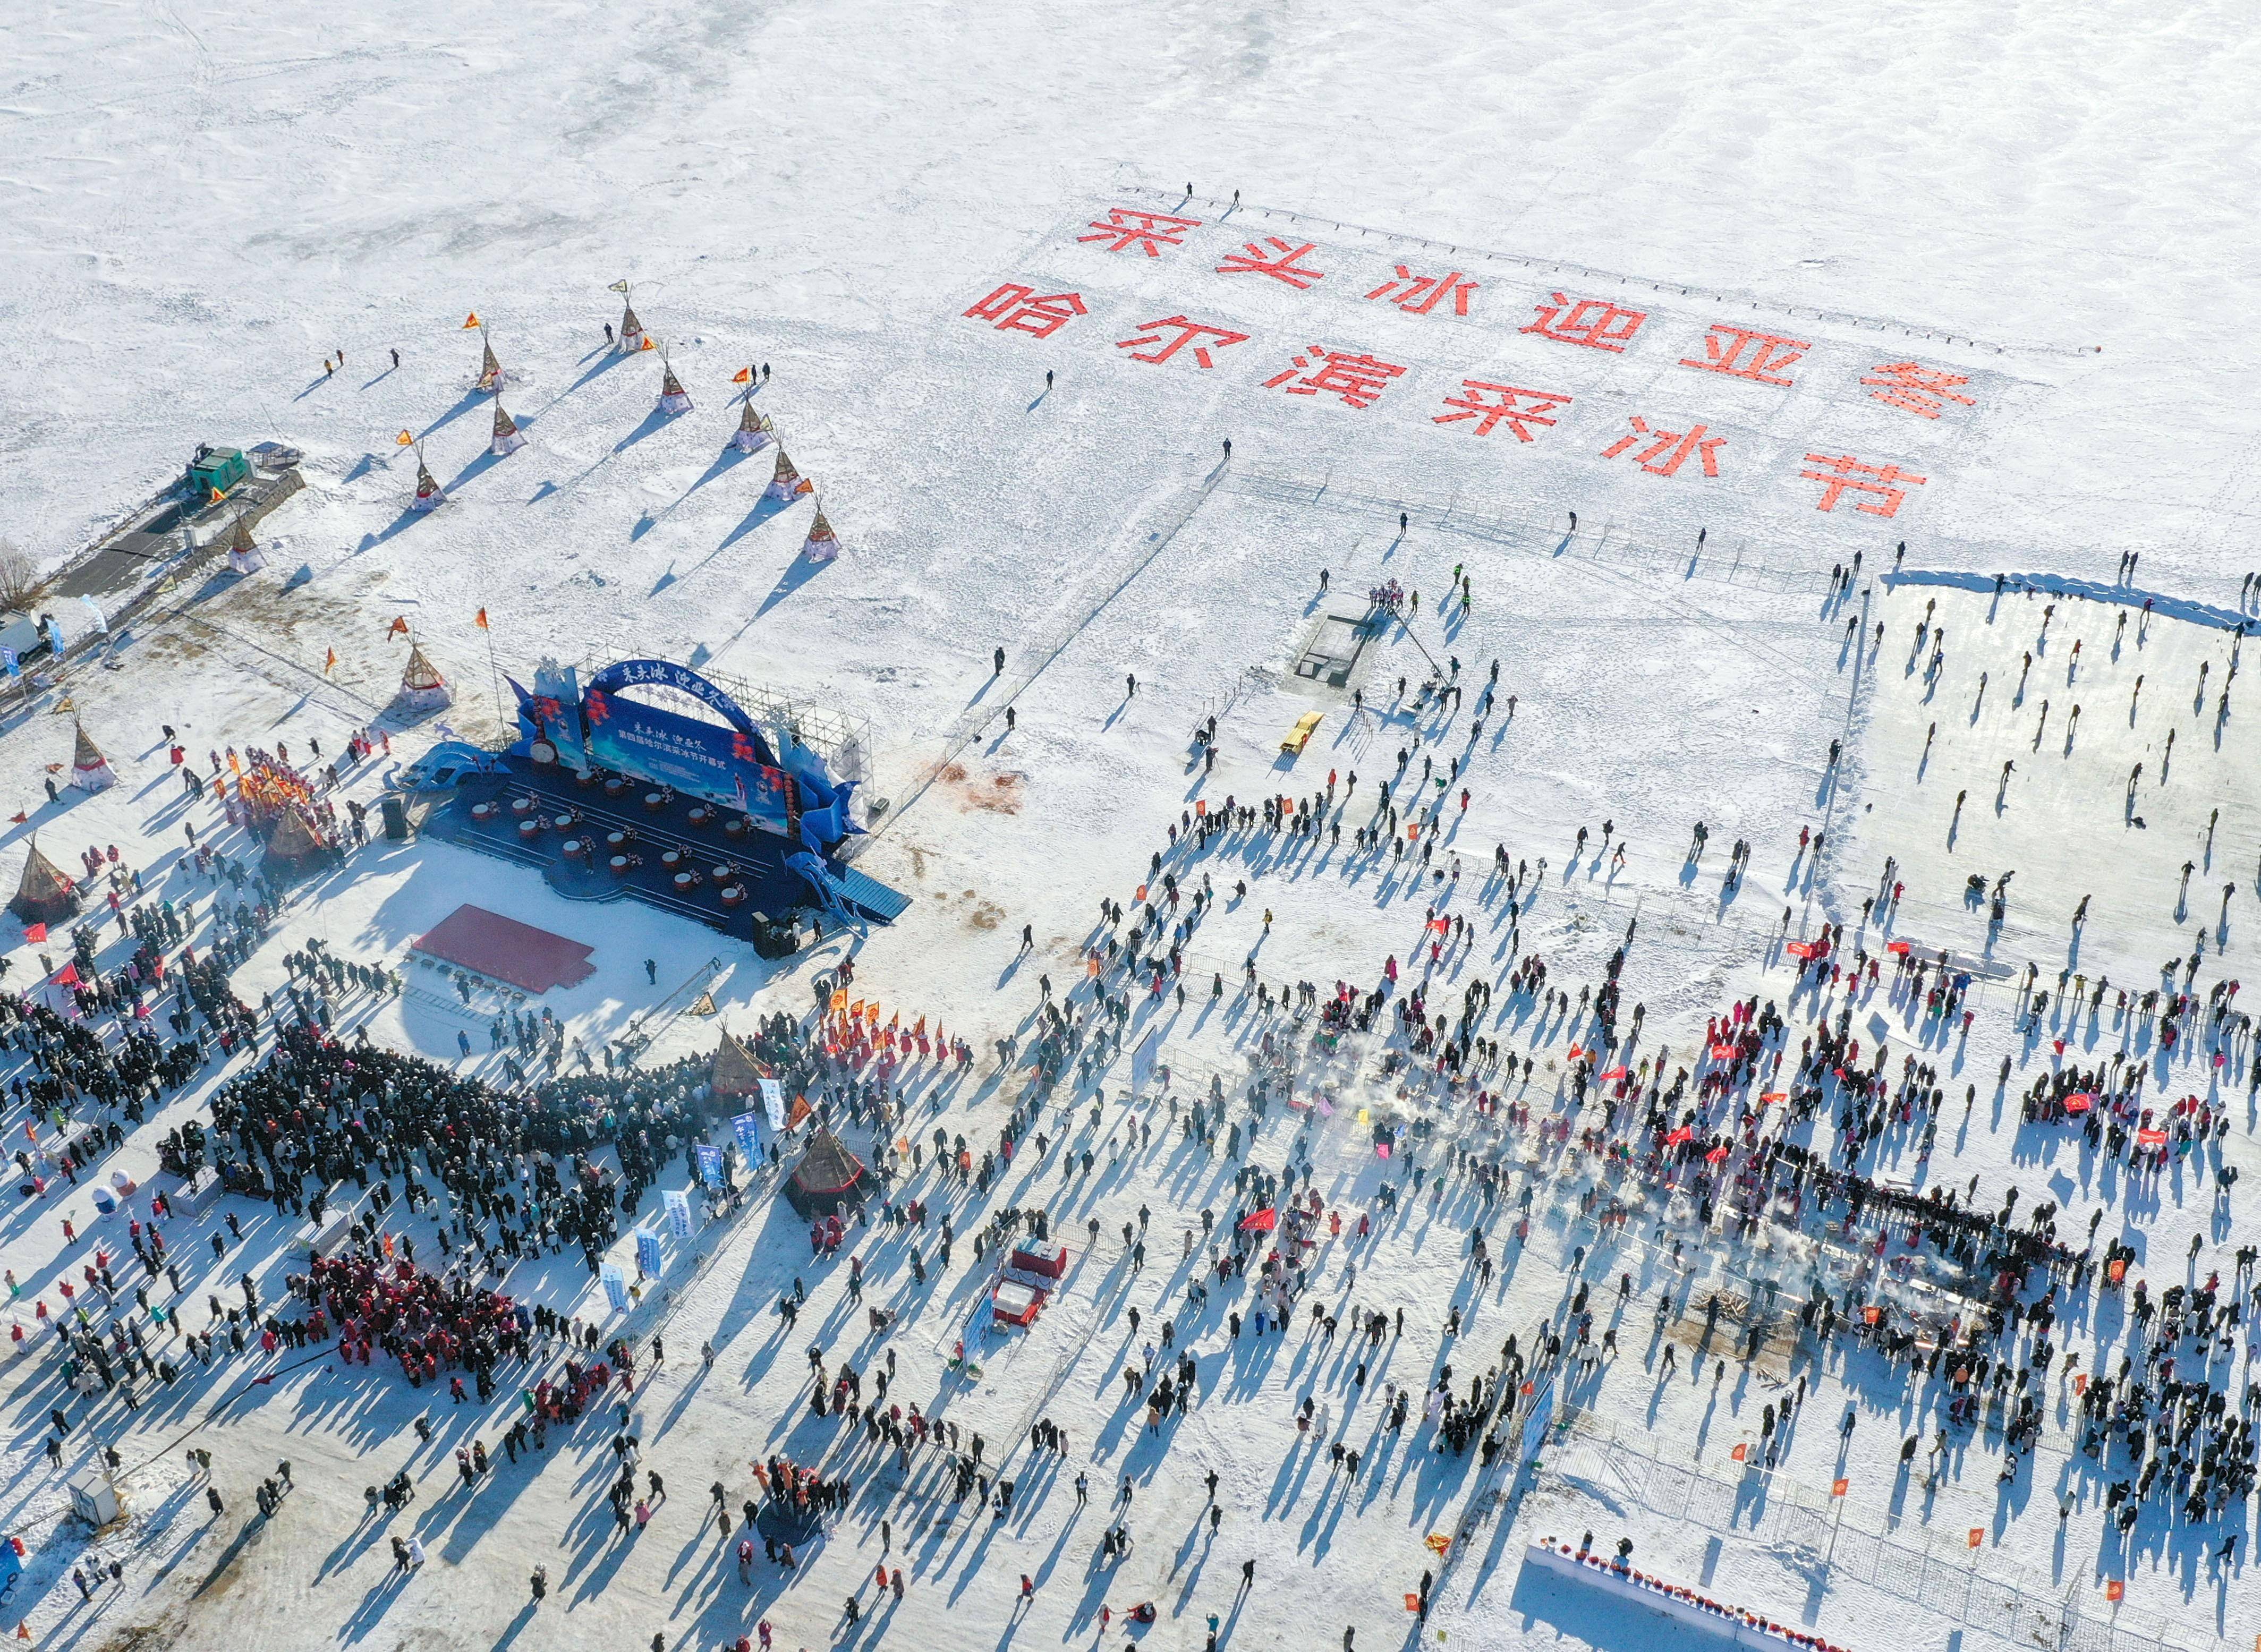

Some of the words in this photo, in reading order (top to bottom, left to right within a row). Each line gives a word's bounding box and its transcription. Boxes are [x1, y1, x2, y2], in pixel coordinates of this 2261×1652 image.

[962, 283, 1928, 518] 哈尔滨采冰节
[1077, 208, 1977, 419] 采头冰迎亚冬
